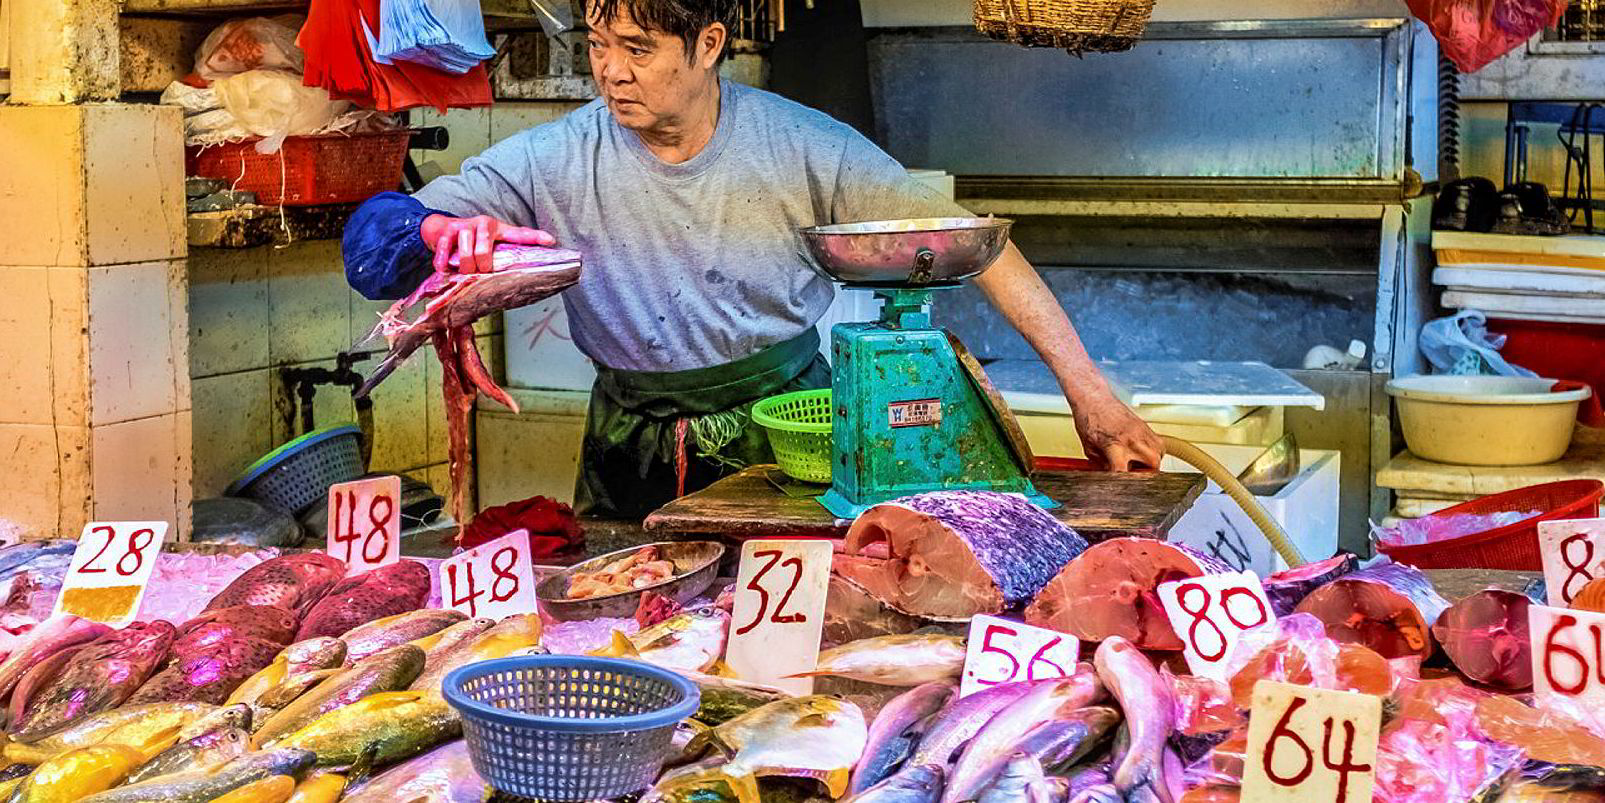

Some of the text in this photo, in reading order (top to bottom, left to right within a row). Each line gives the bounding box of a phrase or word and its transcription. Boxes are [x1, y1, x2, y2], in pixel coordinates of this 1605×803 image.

[78, 525, 154, 576] 28
[334, 490, 393, 564] 48
[447, 545, 519, 617] 48
[736, 549, 806, 636] 32
[976, 624, 1066, 686] 56
[1175, 583, 1268, 663] 80
[1263, 696, 1372, 803] 64
